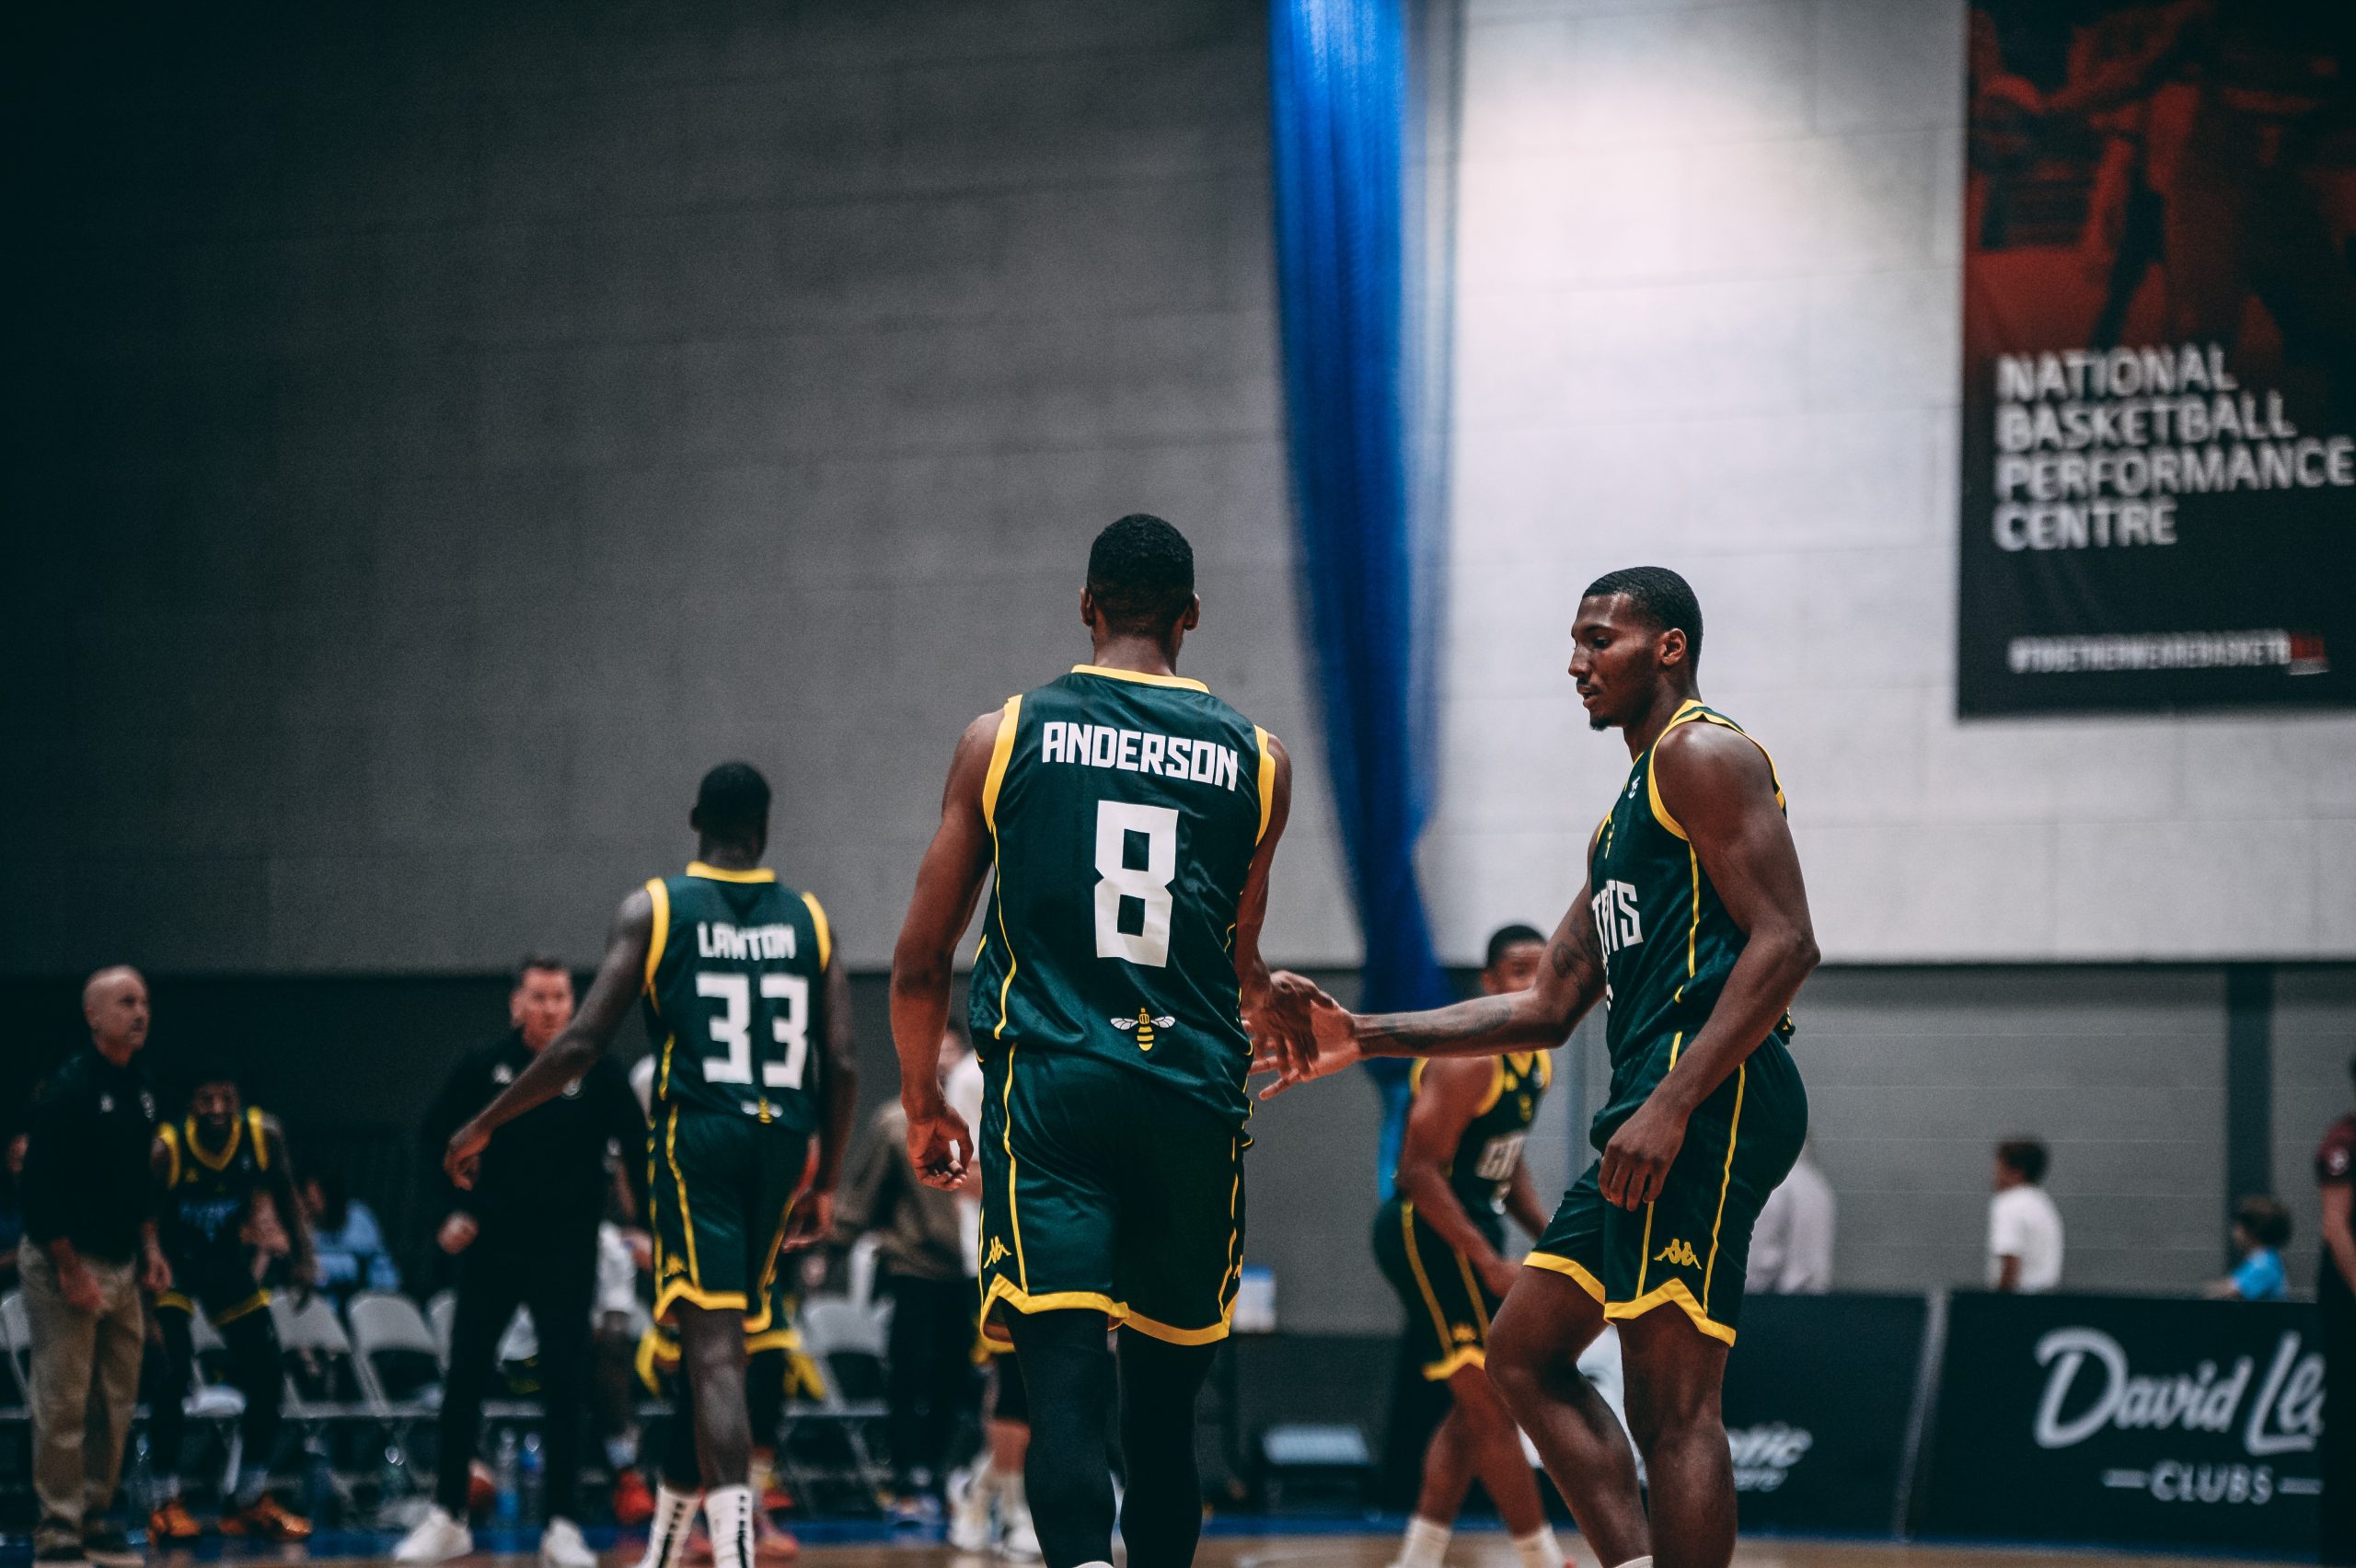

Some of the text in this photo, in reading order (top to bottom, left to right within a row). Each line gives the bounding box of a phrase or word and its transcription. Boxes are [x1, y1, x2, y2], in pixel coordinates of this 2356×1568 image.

[1995, 343, 2238, 401] NATIONAL
[1994, 391, 2299, 453] BASKETBALL
[1995, 436, 2355, 502] PERFORMANCE
[1992, 498, 2178, 551] CENTRE
[1042, 721, 1238, 791] ANDERSON
[1094, 800, 1179, 968] 8
[697, 921, 796, 961] LAWTON
[695, 972, 809, 1090] 33
[2035, 1326, 2254, 1448] David
[2150, 1460, 2273, 1505] CLUBS
